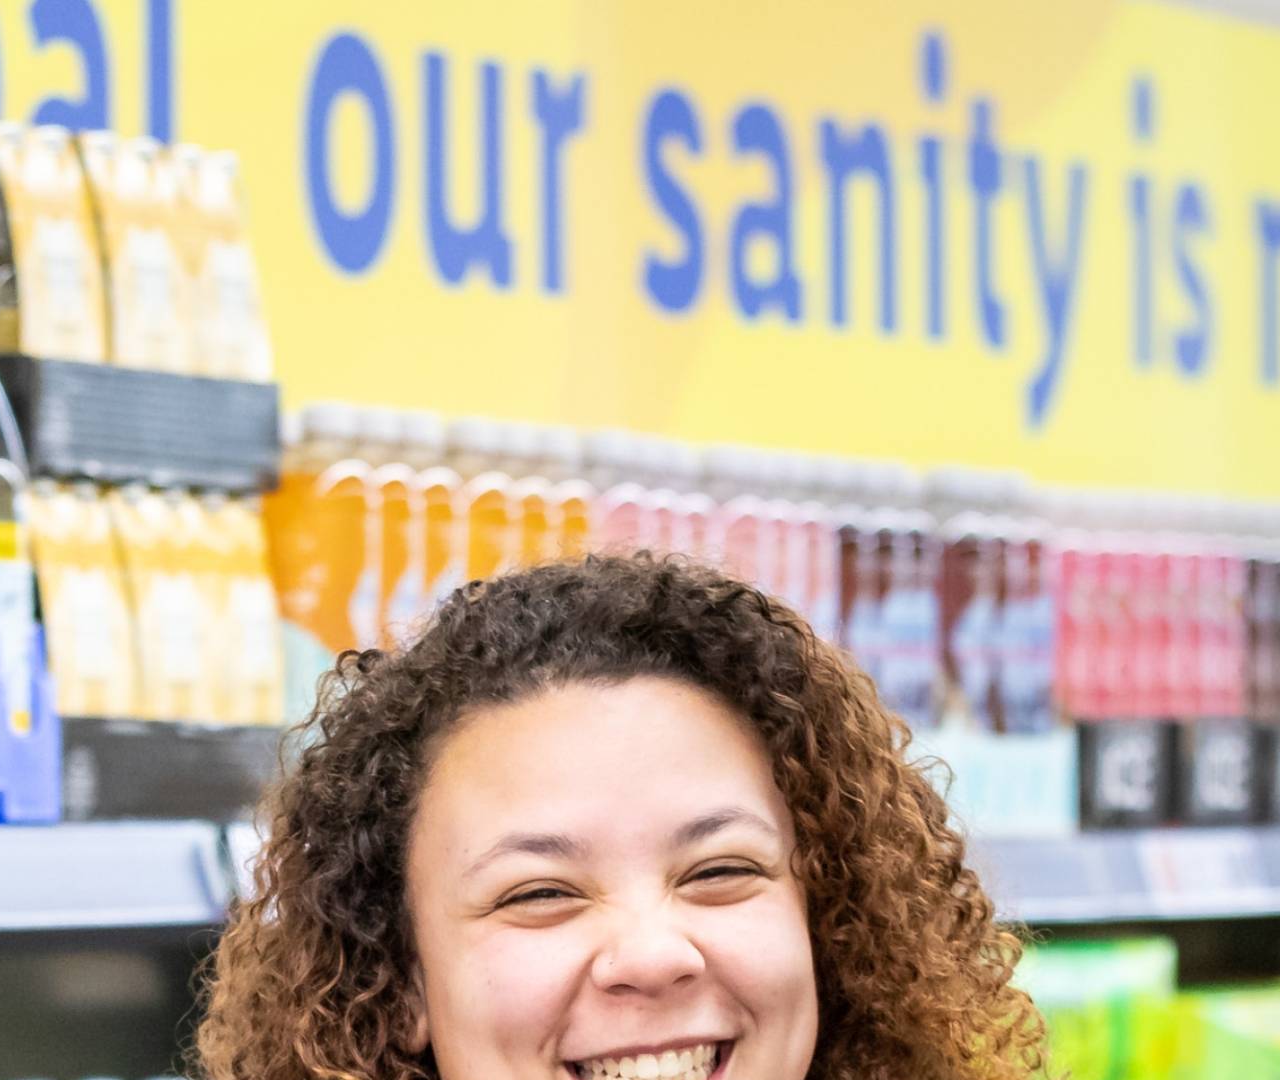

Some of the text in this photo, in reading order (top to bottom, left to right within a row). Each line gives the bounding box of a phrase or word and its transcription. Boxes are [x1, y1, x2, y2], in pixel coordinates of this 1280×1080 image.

[303, 31, 587, 295] our
[641, 29, 1090, 430] sanity
[1132, 75, 1211, 377] is
